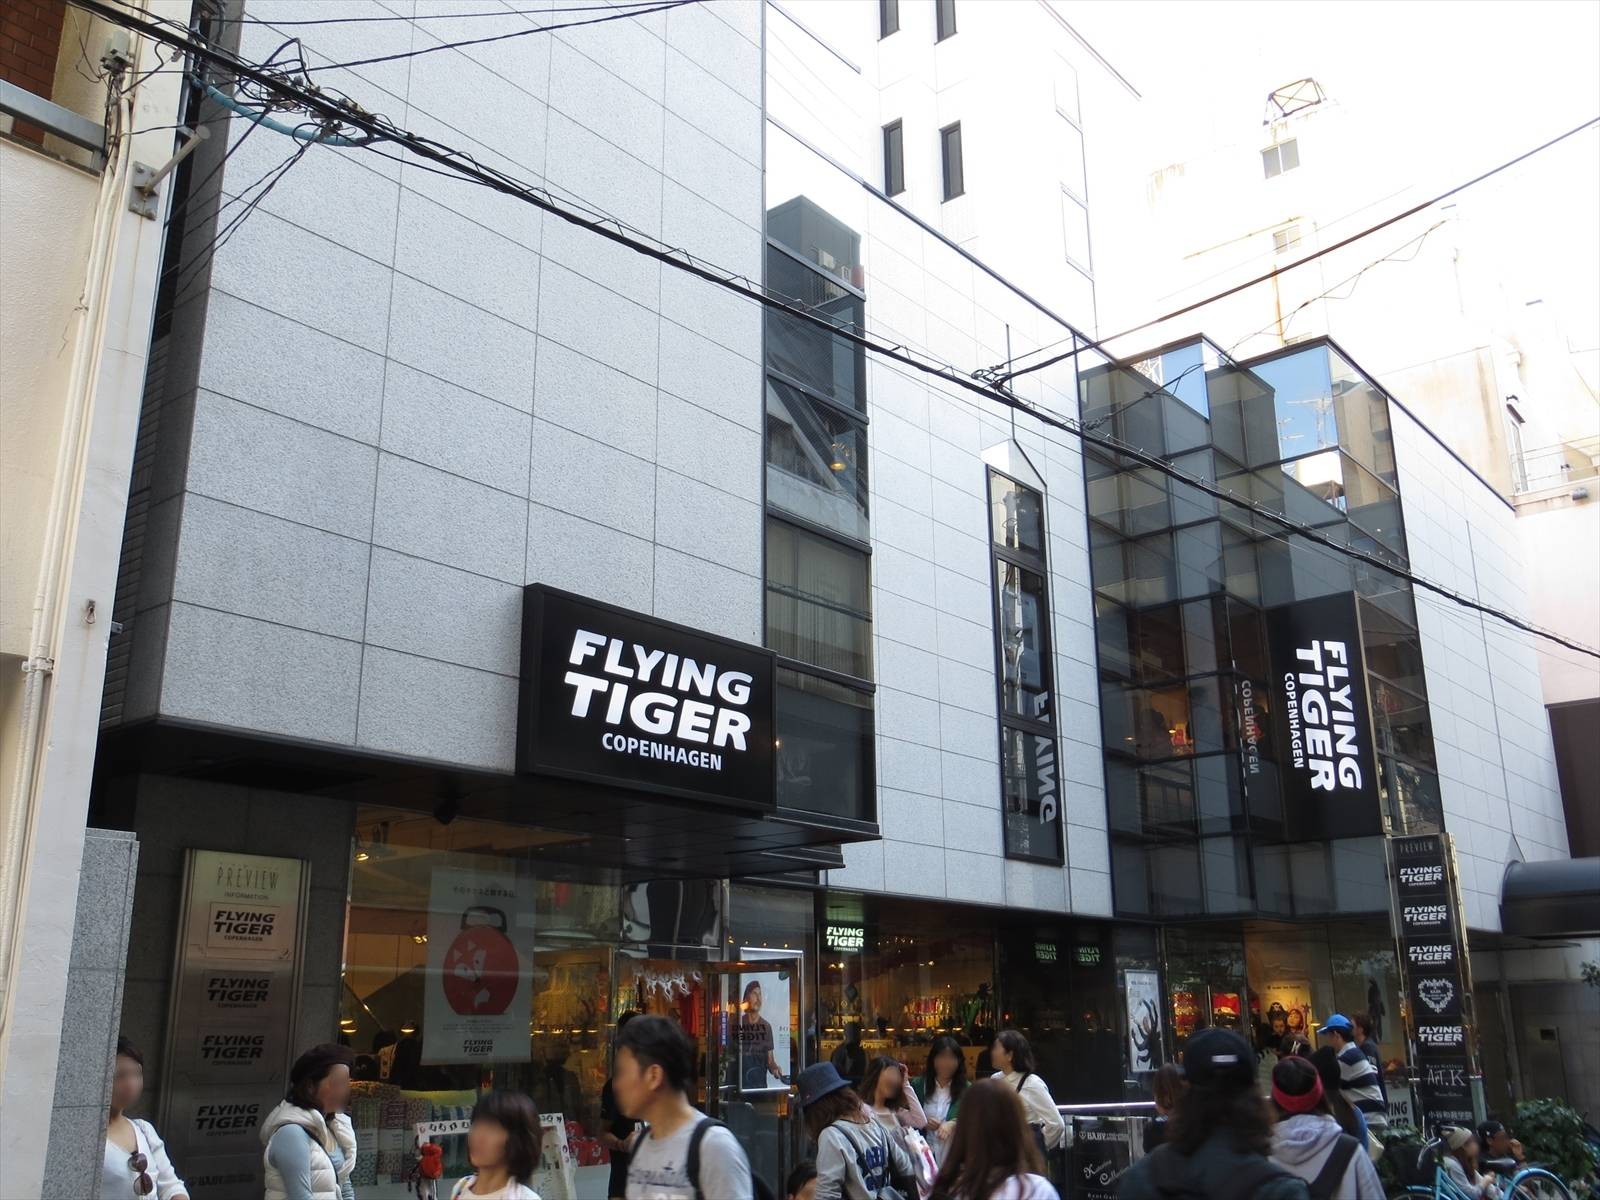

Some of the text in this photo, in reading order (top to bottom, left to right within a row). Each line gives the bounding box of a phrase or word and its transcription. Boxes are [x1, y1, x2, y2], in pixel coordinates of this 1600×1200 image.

[569, 629, 753, 705] FLYING
[564, 671, 751, 751] TIGER
[1296, 640, 1336, 791] TIGER
[1323, 640, 1362, 790] FLYING
[1284, 672, 1304, 768] COPENHAGEN
[602, 732, 722, 771] COPENHAGEN
[1400, 865, 1442, 875] FLYING
[216, 866, 279, 890] PREVIEW
[1400, 873, 1442, 883] TIGER
[224, 891, 270, 901] INFORMATION
[1404, 904, 1447, 914] FLYING
[215, 910, 276, 923] FLYING
[1403, 912, 1447, 922] TIGER
[214, 921, 274, 936] TIGER
[826, 926, 864, 937] FLYING
[826, 936, 864, 947] TIGER
[1409, 944, 1452, 954] FLYING
[1408, 952, 1453, 962] TIGER
[208, 977, 270, 990] FLYING
[207, 989, 268, 1003] TIGER
[1418, 1025, 1462, 1034] FLYING
[203, 1035, 264, 1047] FLYING
[1418, 1033, 1463, 1042] TIGER
[202, 1046, 263, 1059] TIGER
[463, 1045, 493, 1053] TIGER
[197, 1104, 259, 1117] FLYING
[196, 1115, 258, 1130] TIGER
